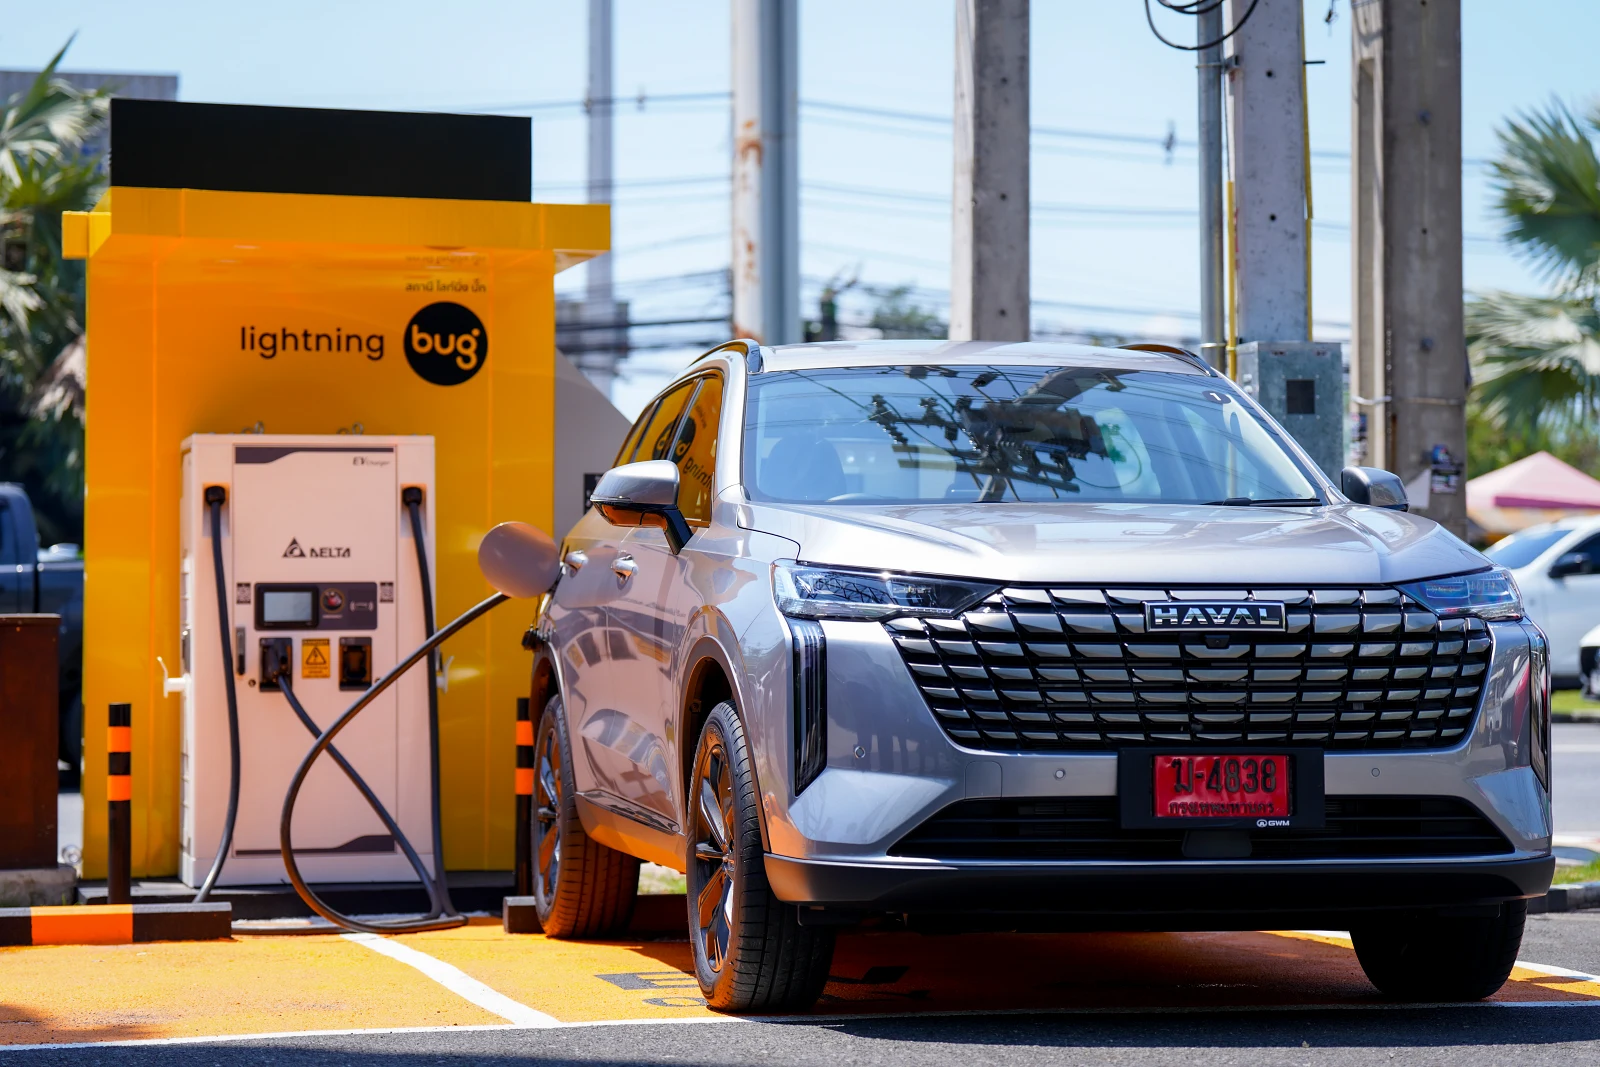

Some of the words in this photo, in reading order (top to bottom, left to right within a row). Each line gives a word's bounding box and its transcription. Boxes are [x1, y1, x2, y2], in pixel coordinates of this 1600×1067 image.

[240, 326, 385, 361] lightning
[411, 324, 481, 370] bug
[1209, 392, 1222, 401] 1
[309, 547, 351, 558] DELTA
[1153, 607, 1281, 625] HAVAL
[1268, 819, 1290, 827] GWM
